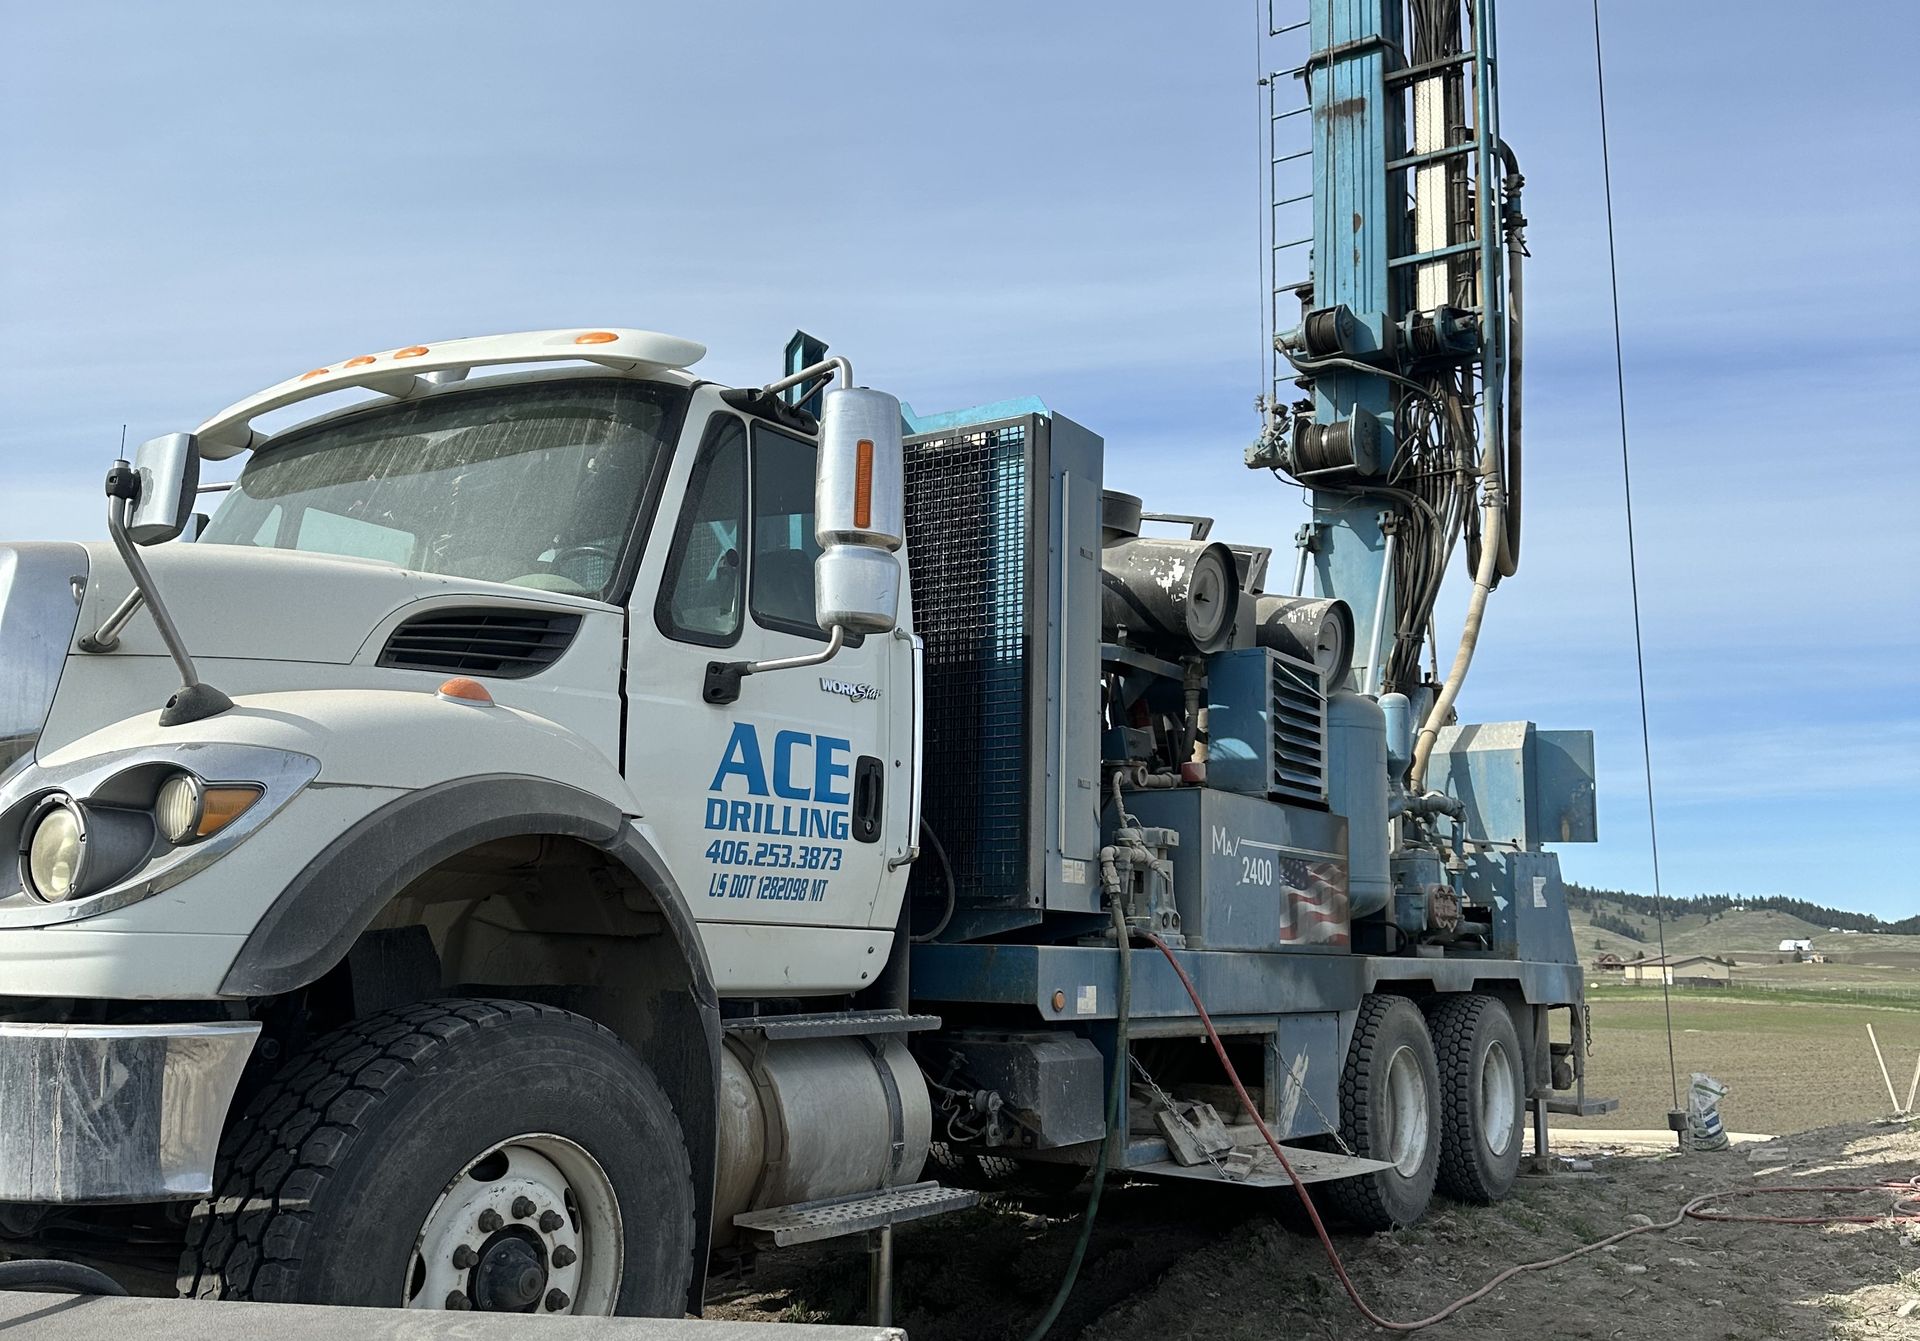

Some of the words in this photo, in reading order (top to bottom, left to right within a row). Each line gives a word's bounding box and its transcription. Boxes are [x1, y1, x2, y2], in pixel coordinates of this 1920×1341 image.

[708, 721, 851, 805] ACE
[704, 797, 849, 841] DRILLING
[705, 839, 843, 871] 406.253.3873
[1242, 856, 1272, 886] 2400
[709, 873, 729, 897] US
[728, 874, 756, 899] DOT
[757, 876, 809, 901] 1282098
[808, 879, 829, 902] MT
